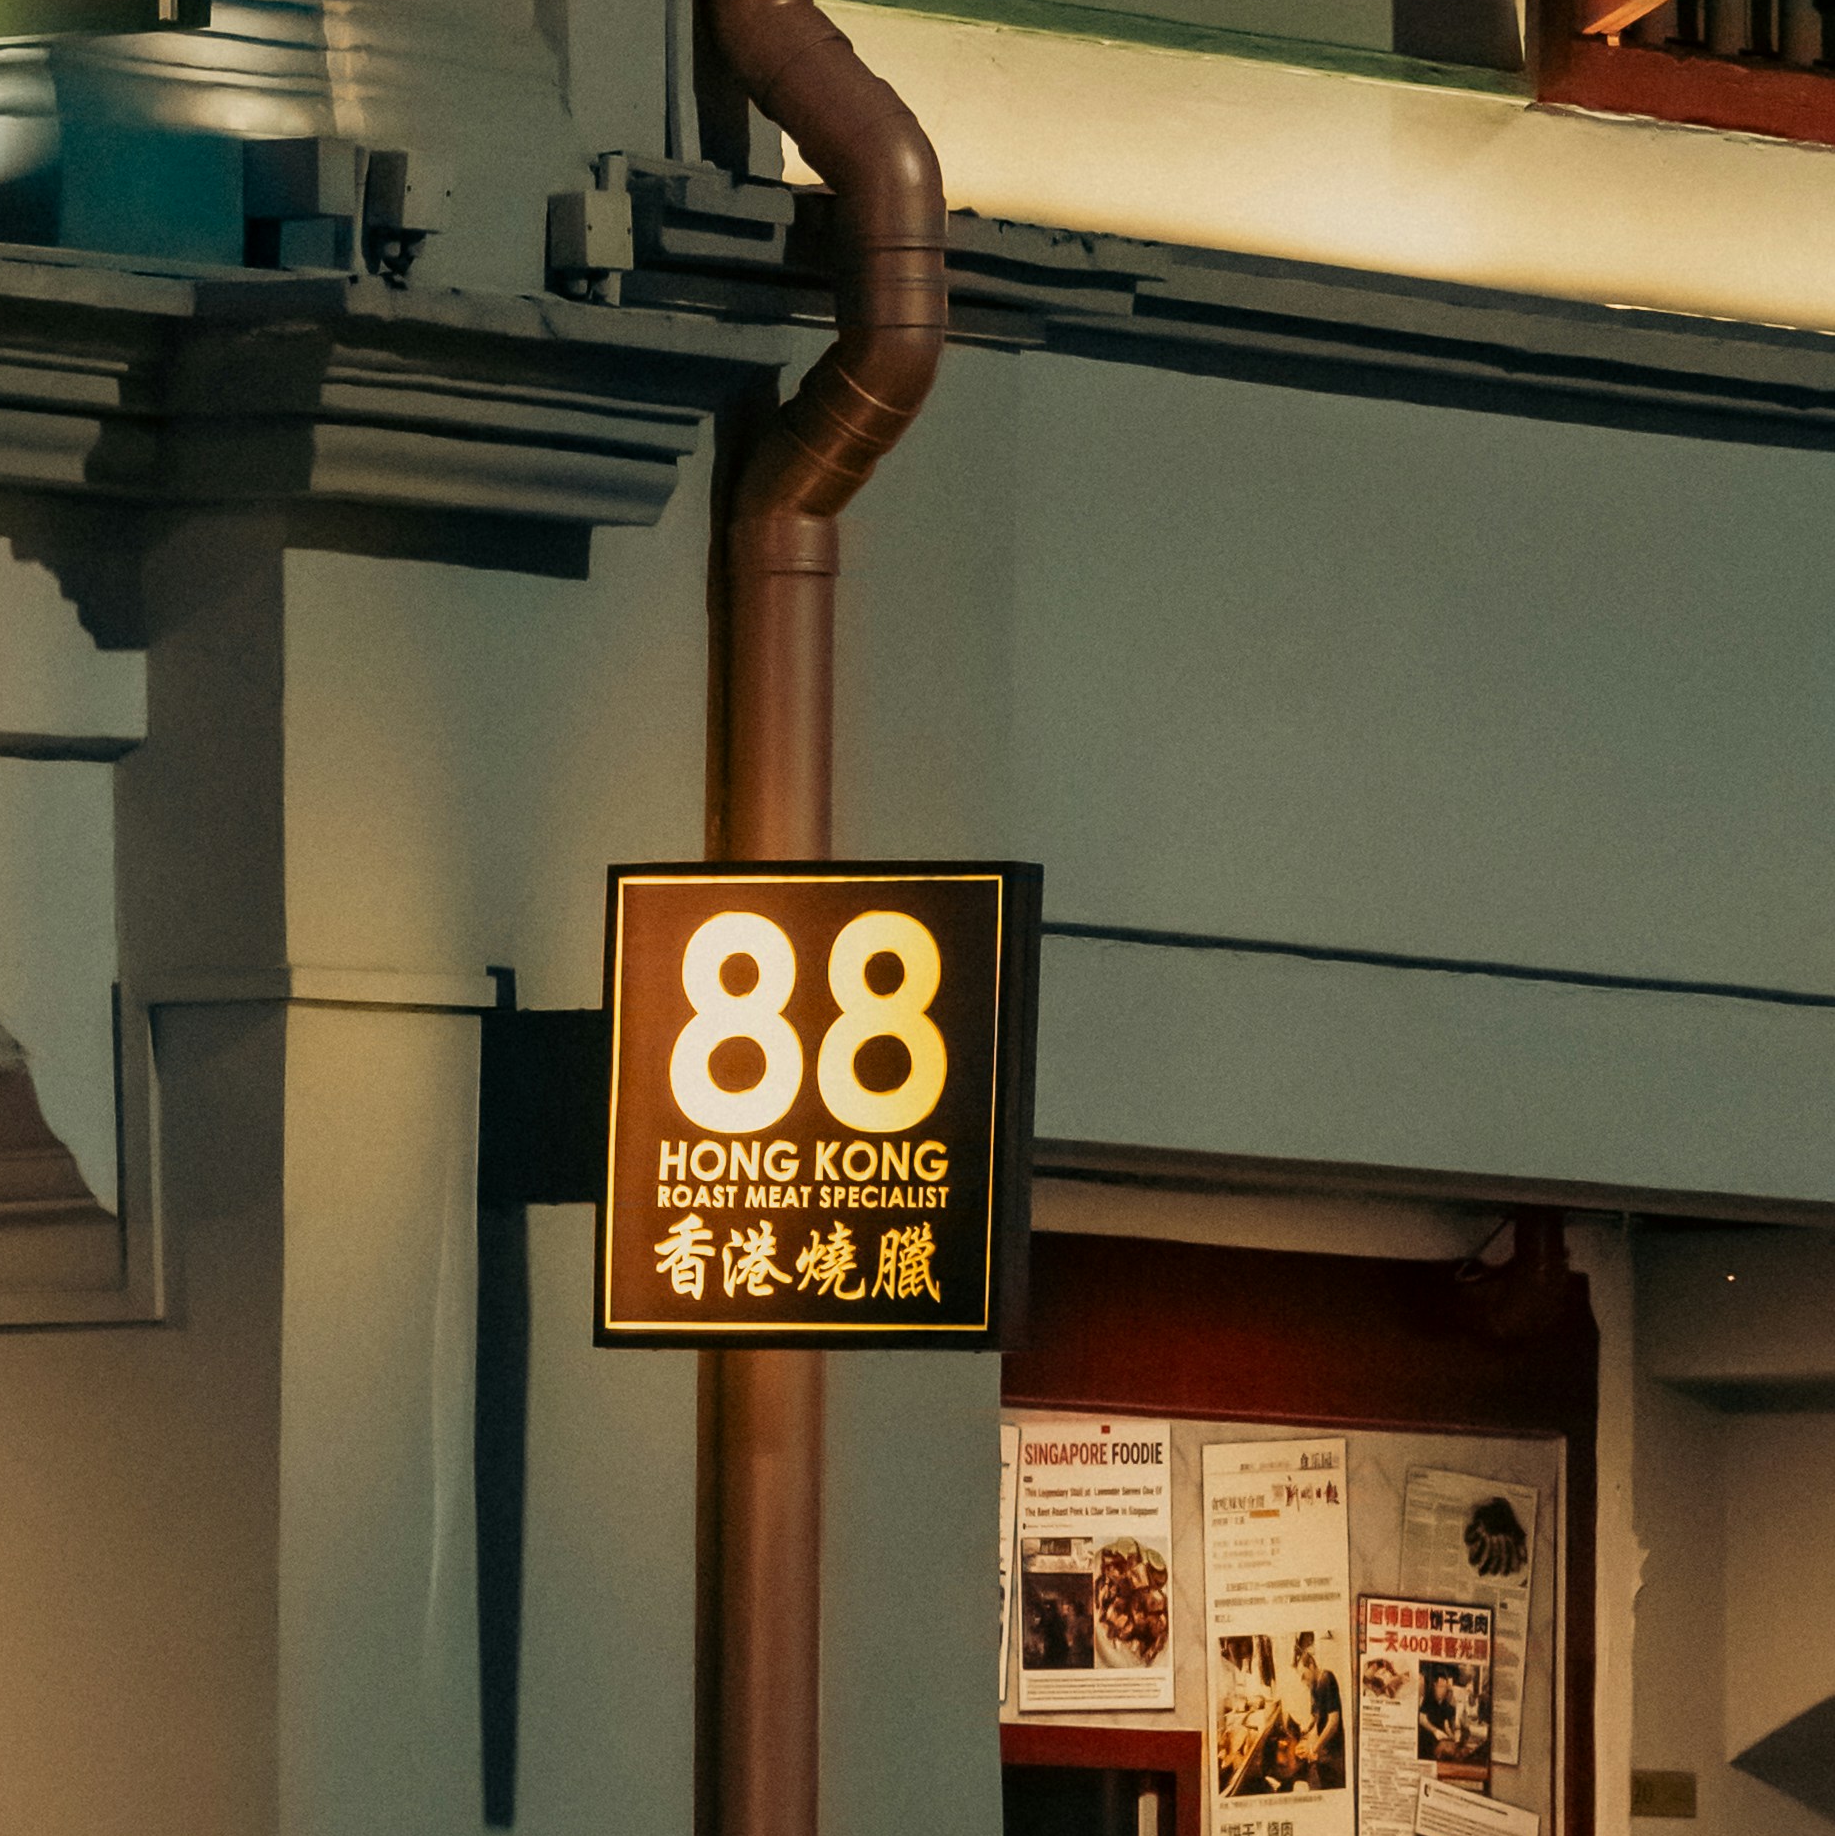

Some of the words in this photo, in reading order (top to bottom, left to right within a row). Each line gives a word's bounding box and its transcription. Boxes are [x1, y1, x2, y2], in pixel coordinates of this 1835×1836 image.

[669, 910, 947, 1134] 88
[658, 1139, 800, 1183] HONG
[815, 1139, 949, 1182] KONG
[656, 1184, 737, 1210] ROAST
[744, 1184, 812, 1210] MEAT
[819, 1184, 950, 1210] SPECIALIST
[1024, 1442, 1108, 1465] SINGAPORE
[1111, 1441, 1164, 1465] FOODIE
